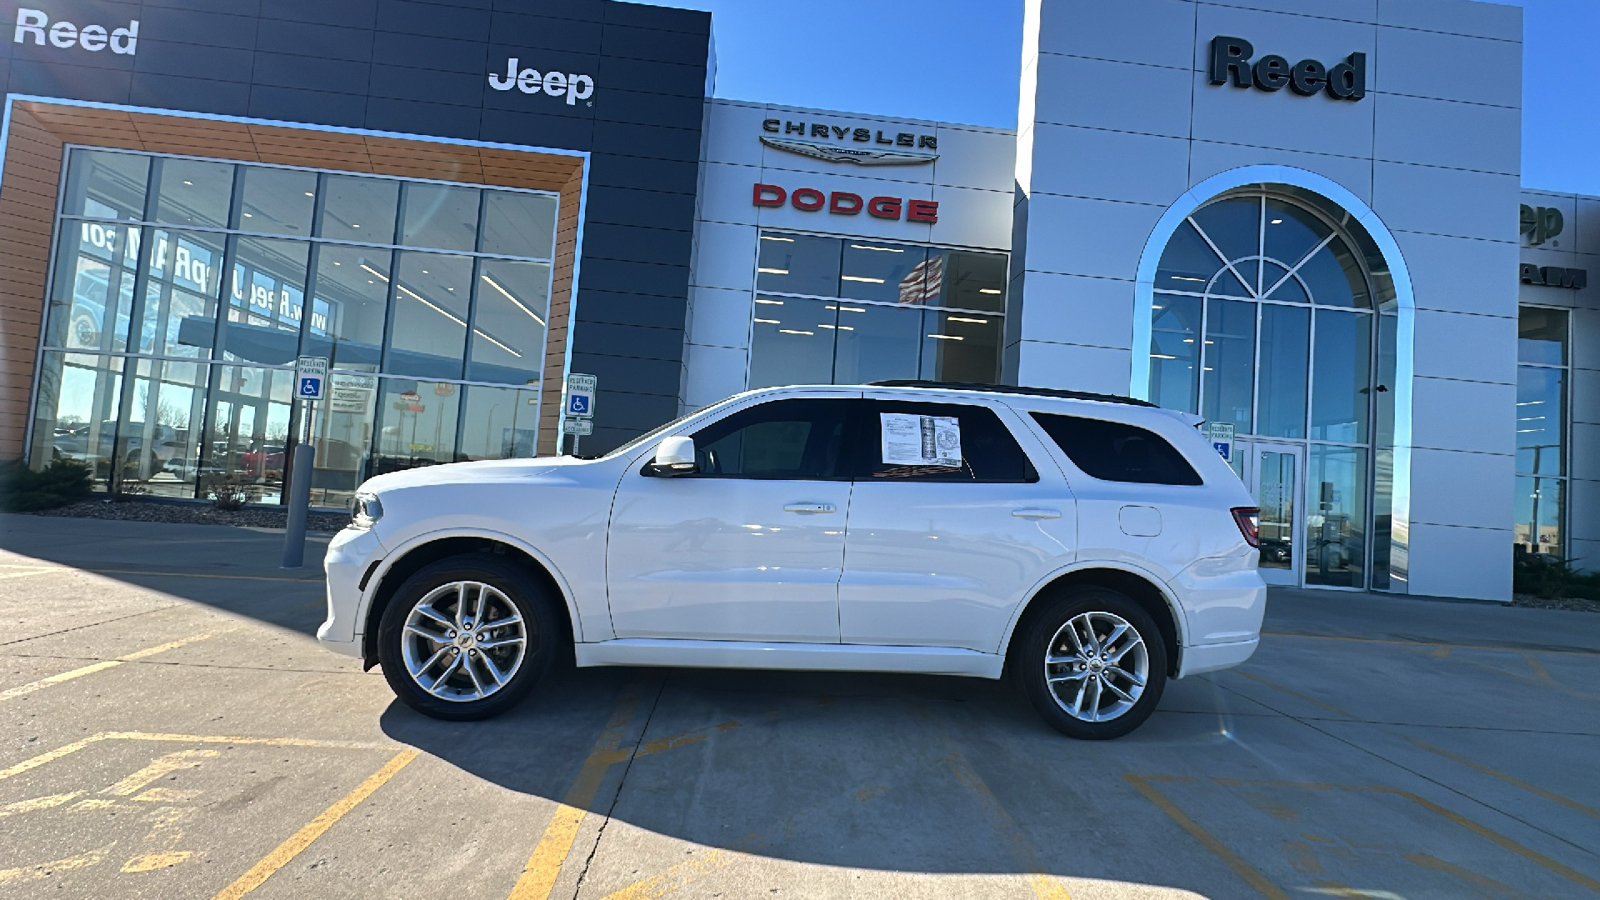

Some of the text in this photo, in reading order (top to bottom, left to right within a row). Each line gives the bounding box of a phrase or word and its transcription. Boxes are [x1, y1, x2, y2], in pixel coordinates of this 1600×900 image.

[14, 8, 138, 55] Reed
[488, 57, 594, 105] Jeep
[1209, 35, 1366, 101] Reed
[762, 119, 937, 149] CHRYSLER
[753, 183, 939, 223] DODGE
[300, 359, 325, 368] RESERVED
[300, 367, 324, 375] PARKING
[569, 377, 593, 385] RESERVED
[569, 384, 592, 392] PARKING
